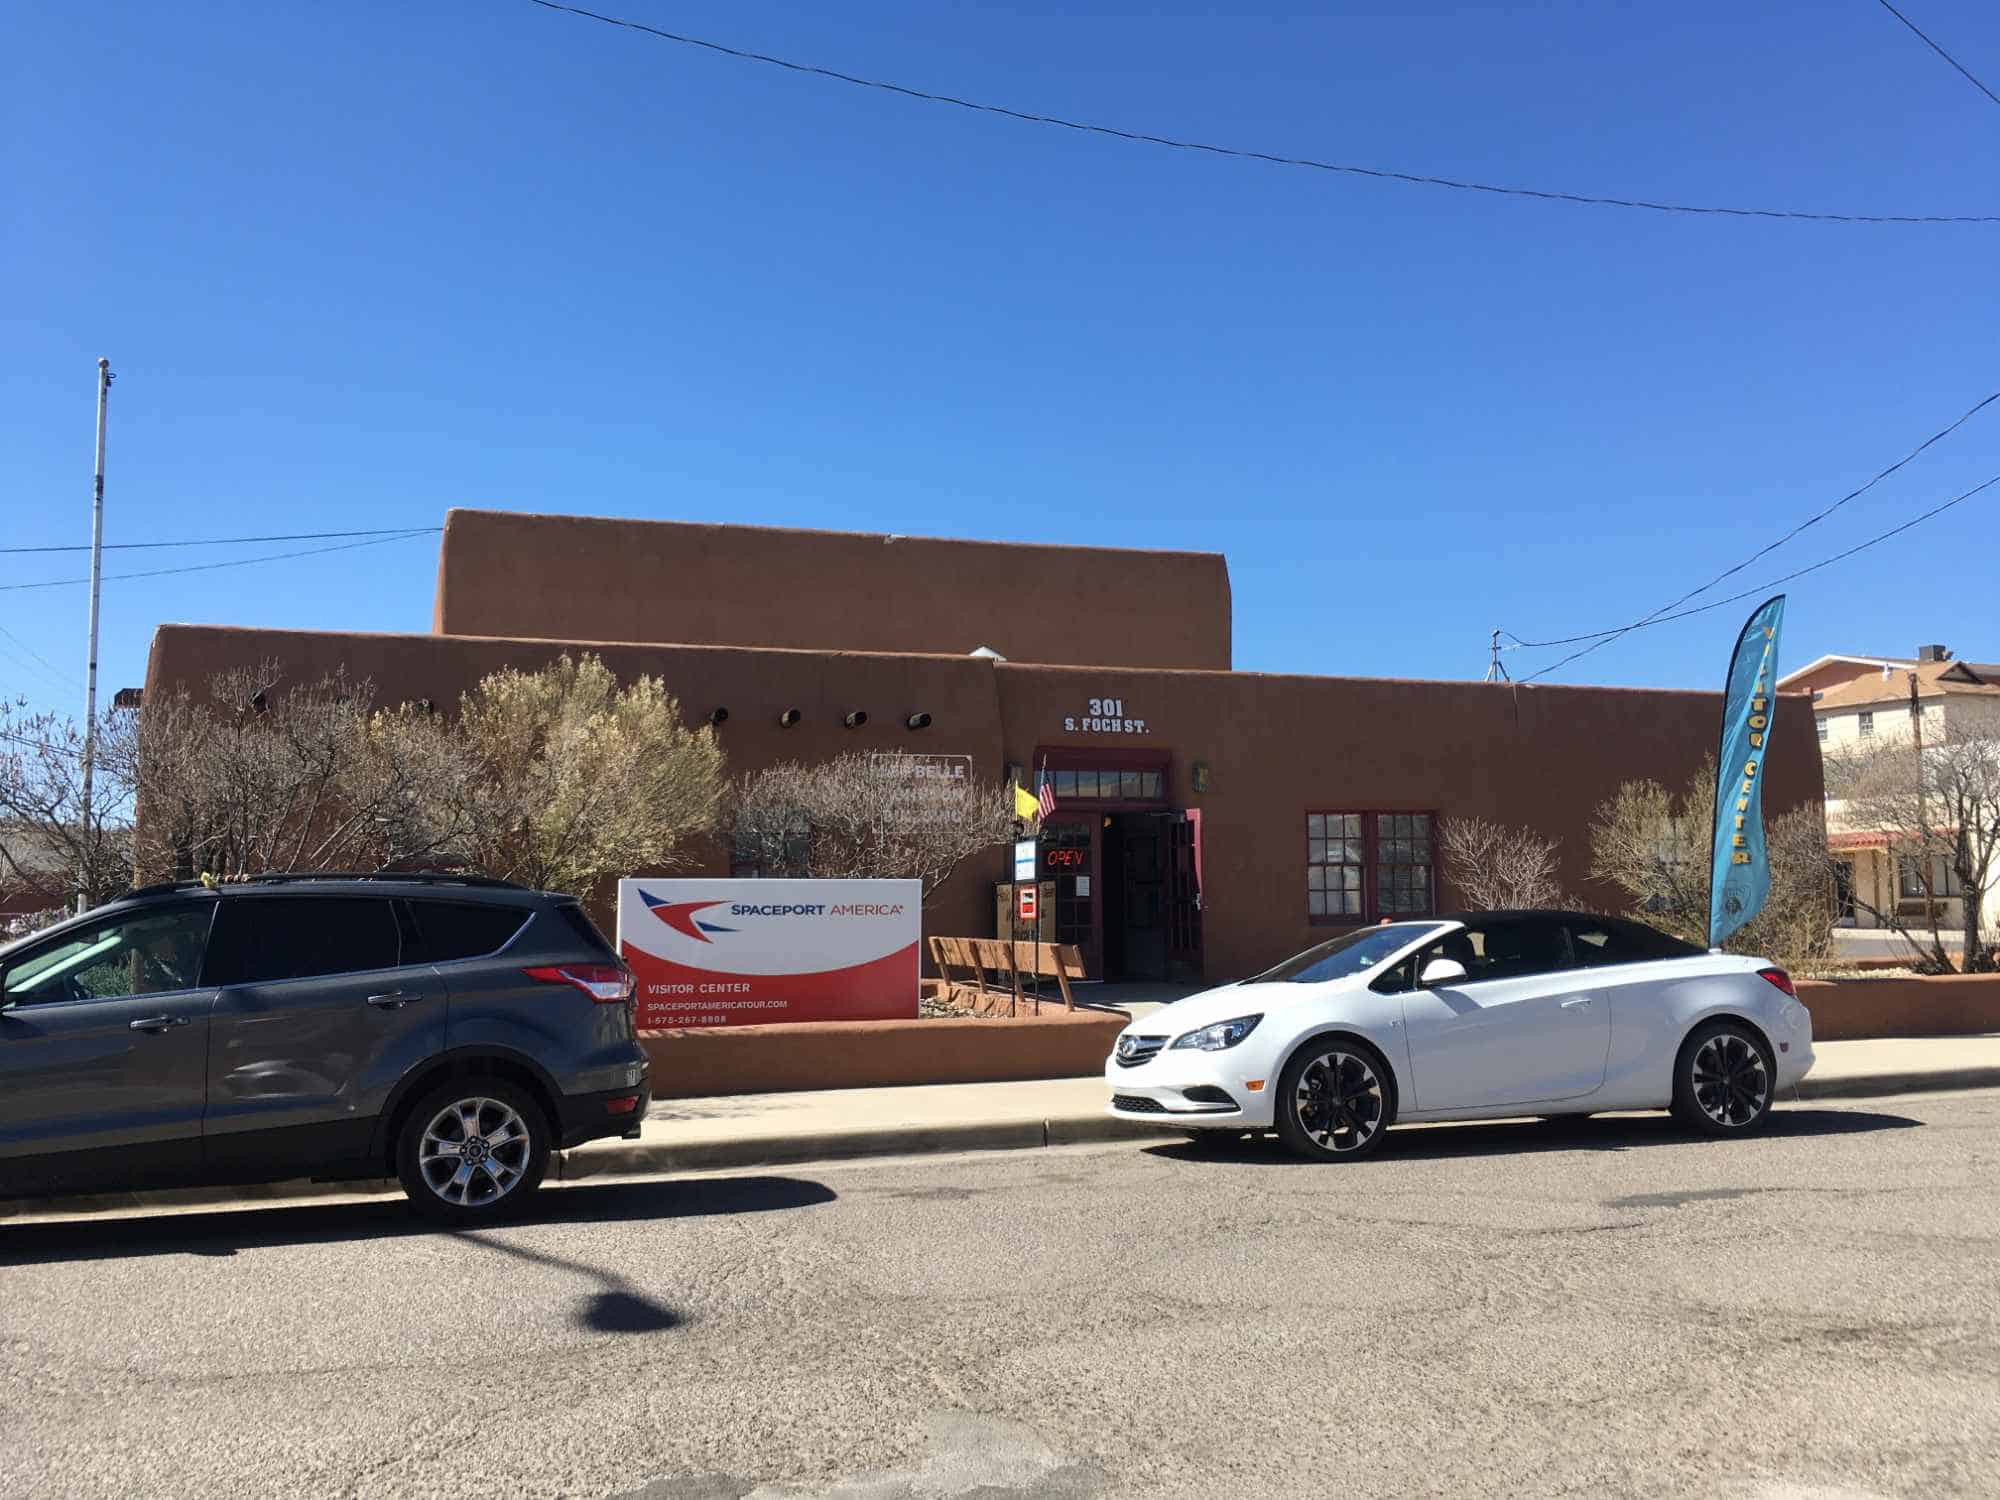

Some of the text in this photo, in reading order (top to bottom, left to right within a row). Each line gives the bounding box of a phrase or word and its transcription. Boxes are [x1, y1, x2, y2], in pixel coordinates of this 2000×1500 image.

[1088, 698, 1122, 716] 301
[1064, 718, 1150, 733] S. FOCH ST.
[1731, 760, 1758, 865] CENTER
[1047, 848, 1084, 866] OPEN
[731, 904, 903, 916] SPACEPORT AMERICA
[647, 983, 751, 994] VISITOR CENTER
[647, 1000, 788, 1011] SPACEPORTAMERICATOUR.COM
